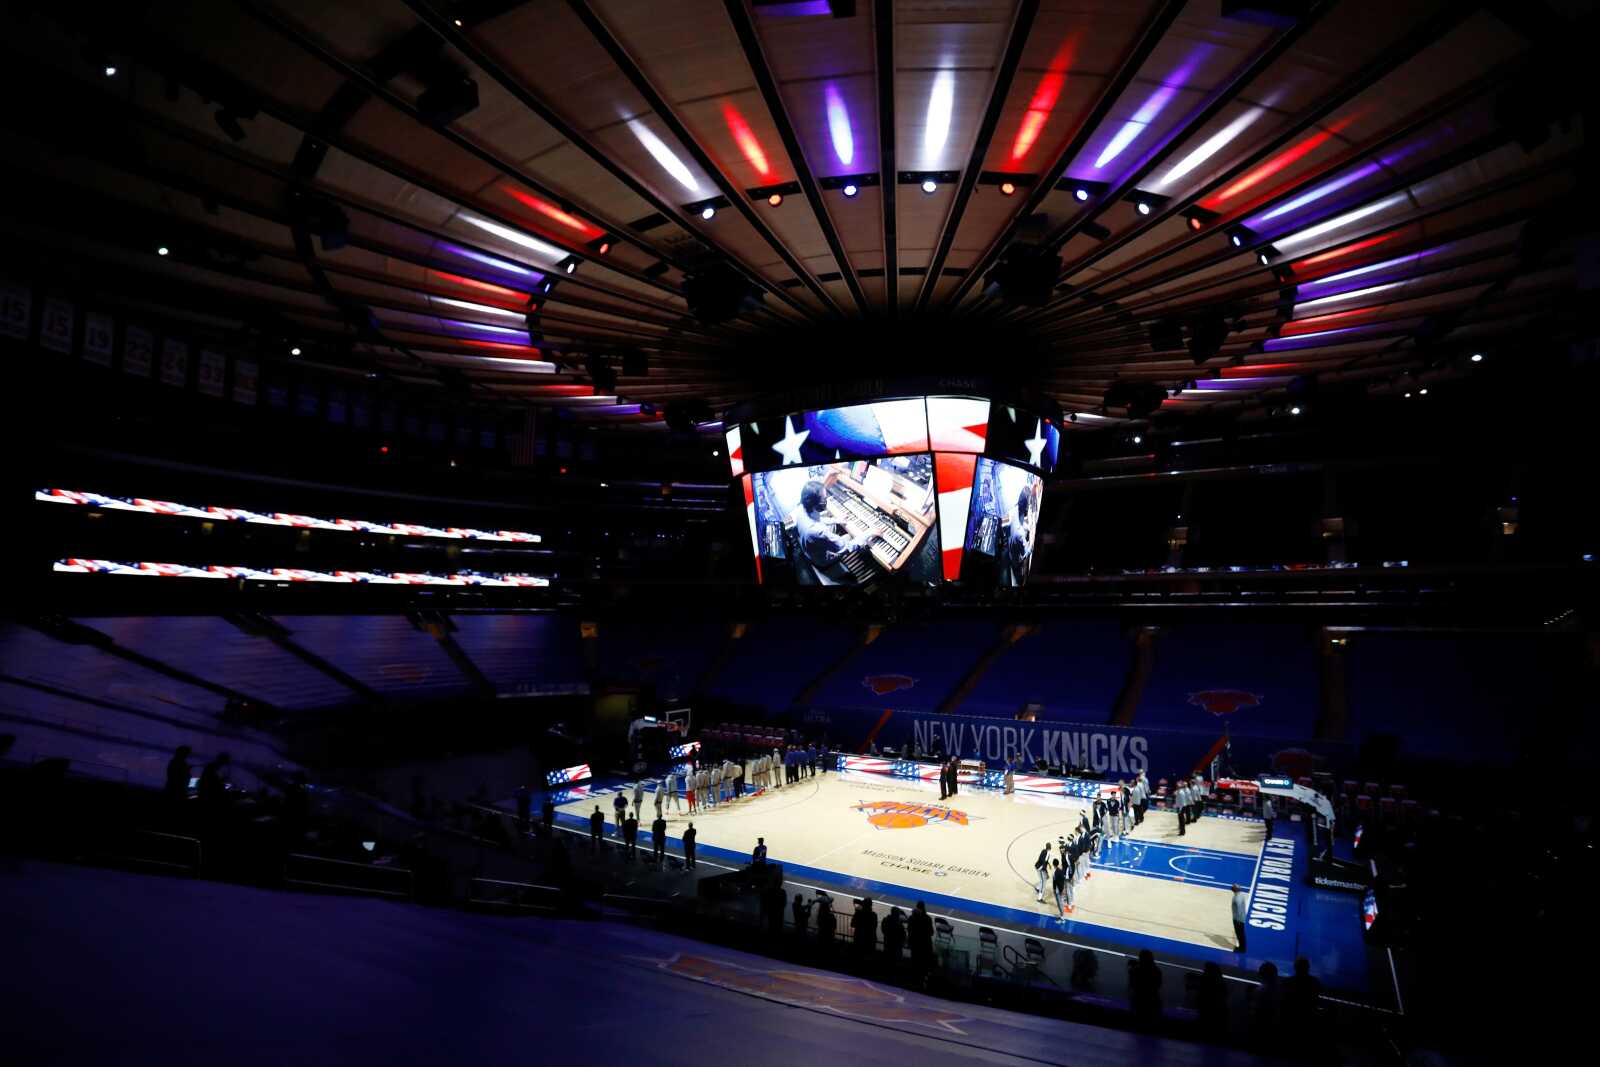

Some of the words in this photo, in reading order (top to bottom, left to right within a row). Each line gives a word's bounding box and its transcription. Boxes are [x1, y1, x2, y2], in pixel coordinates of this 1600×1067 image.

[87, 326, 110, 349] 19
[937, 378, 977, 389] CHASE
[913, 719, 965, 757] NEW
[970, 724, 1036, 764] YORK
[1043, 729, 1149, 774] KNICKS
[1265, 837, 1296, 856] NEW
[861, 848, 906, 862] MADISON
[906, 855, 945, 869] SQUARE
[946, 864, 992, 878] GARDEN
[879, 861, 931, 874] CHASE
[1259, 856, 1293, 882] YORK
[1314, 876, 1368, 891] ticketmaster
[1248, 883, 1290, 931] KNICKS
